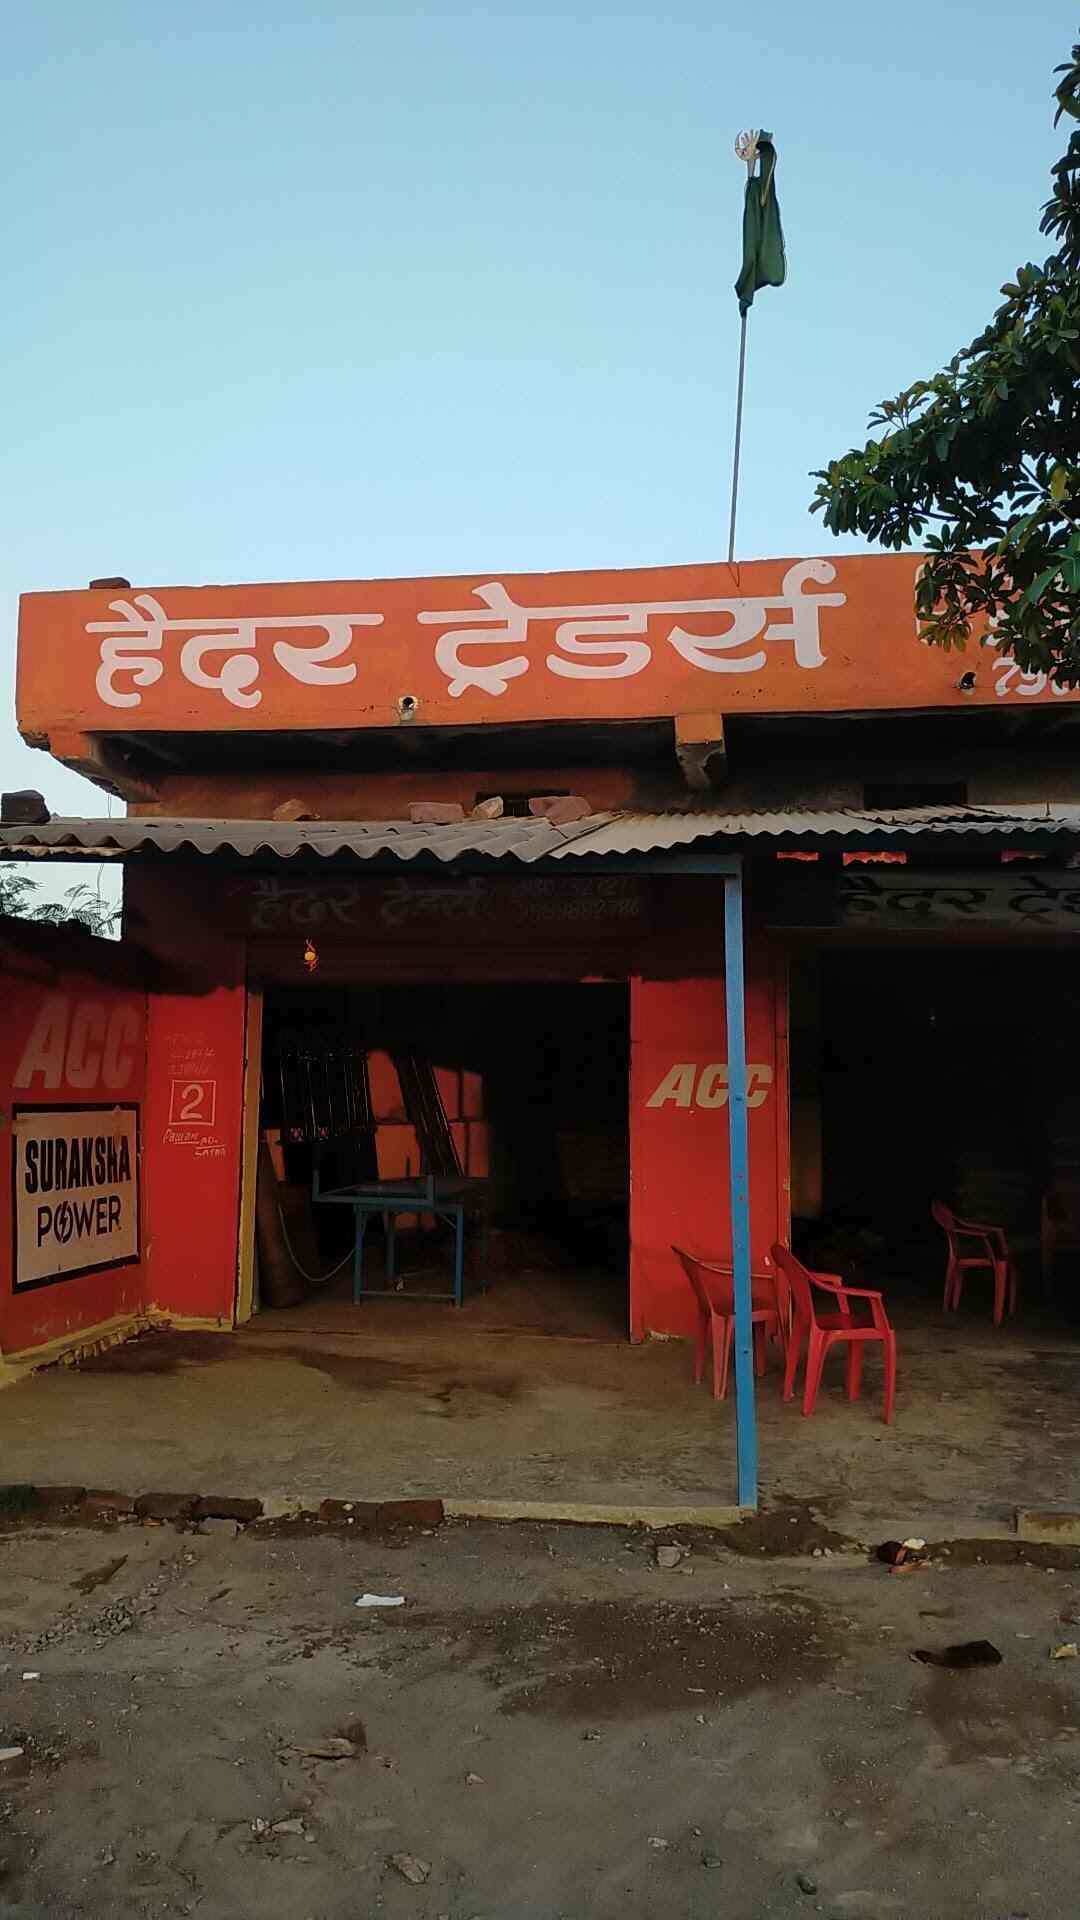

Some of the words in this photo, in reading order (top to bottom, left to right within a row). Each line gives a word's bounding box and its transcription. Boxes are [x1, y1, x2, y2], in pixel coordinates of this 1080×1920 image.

[85, 593, 385, 708] हैदर
[416, 558, 847, 697] ट्रेडर्स
[13, 996, 139, 1088] ACC
[179, 1084, 205, 1120] 2
[645, 1063, 773, 1109] ACC
[25, 1134, 132, 1195] SURAKSHA
[37, 1195, 122, 1248] POWER
